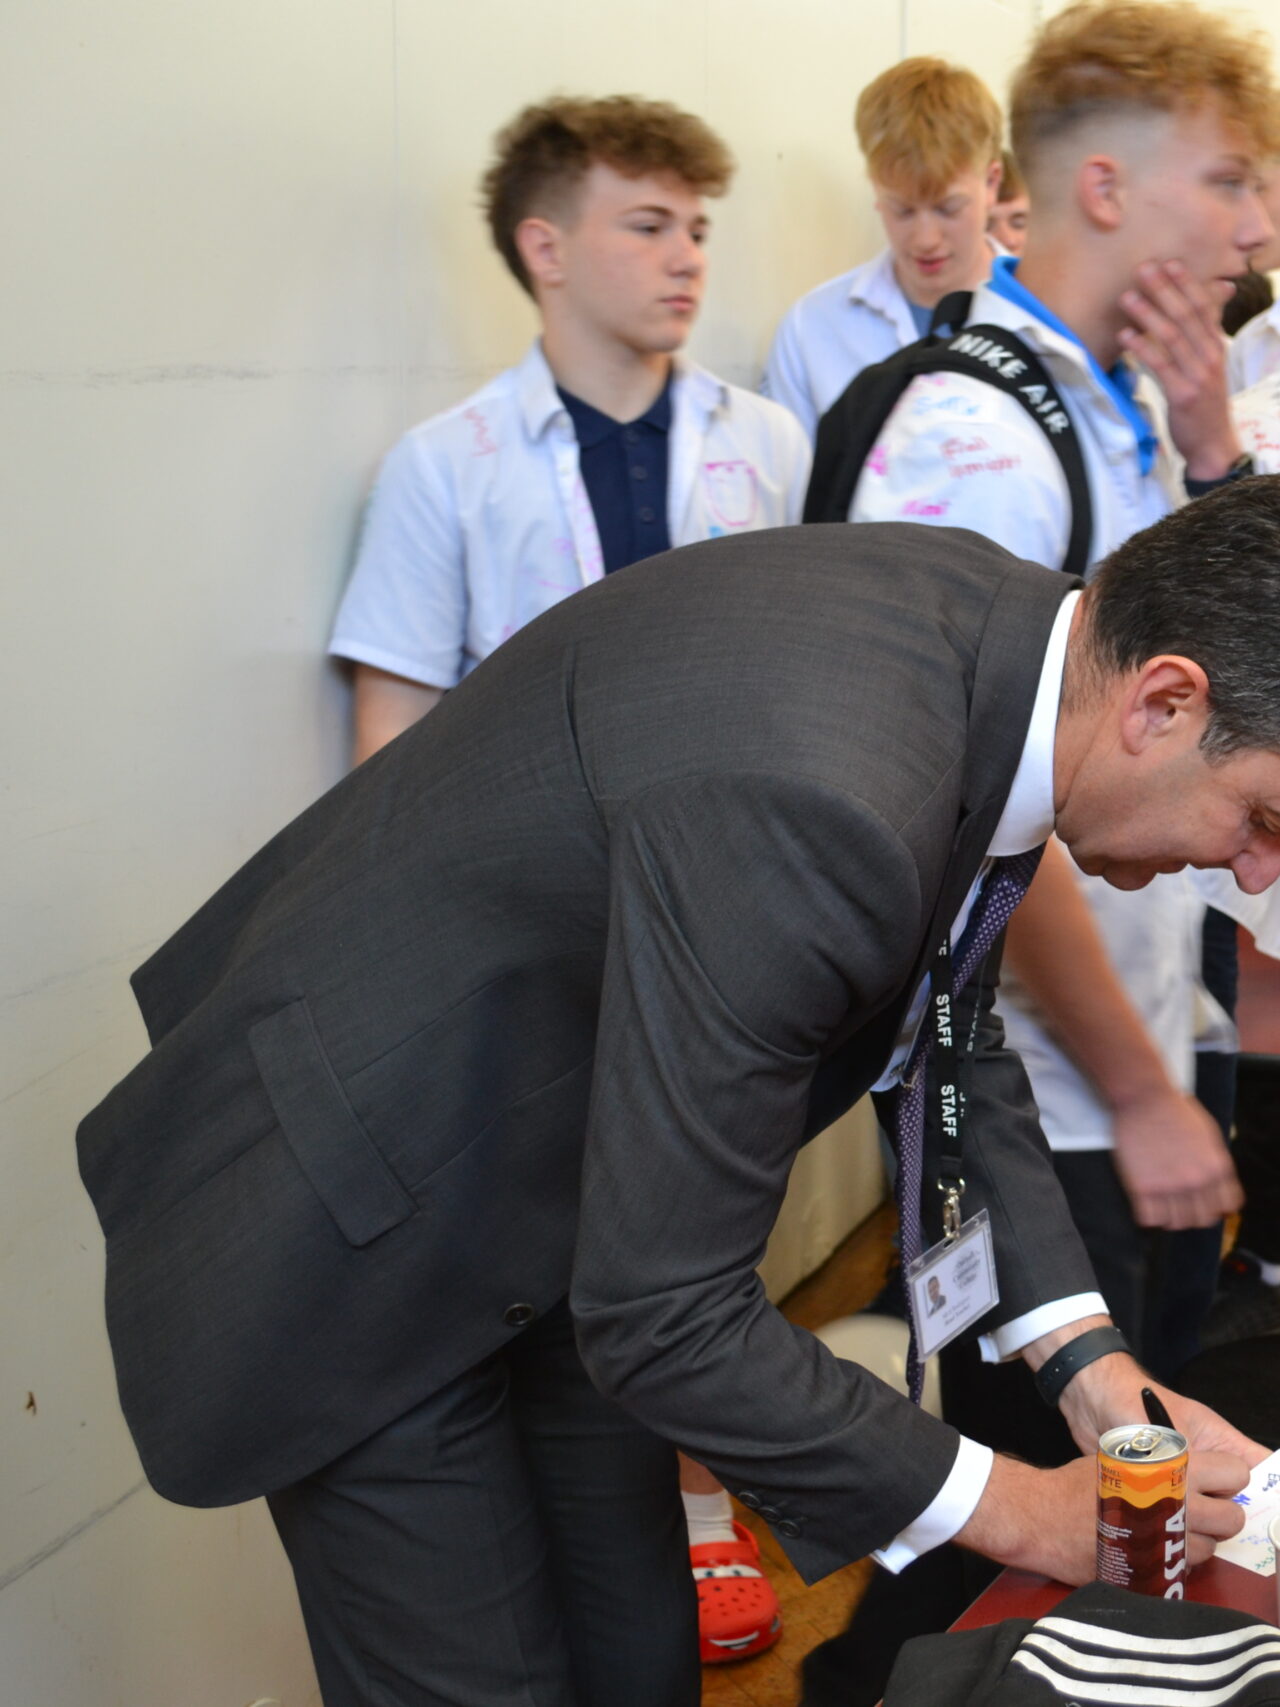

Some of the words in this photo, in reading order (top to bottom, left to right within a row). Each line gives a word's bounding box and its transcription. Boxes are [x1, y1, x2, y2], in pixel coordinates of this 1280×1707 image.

[948, 333, 1028, 379] NIKE
[1018, 384, 1070, 434] AIR
[936, 994, 953, 1047] STAFF
[940, 1084, 957, 1138] STAFF
